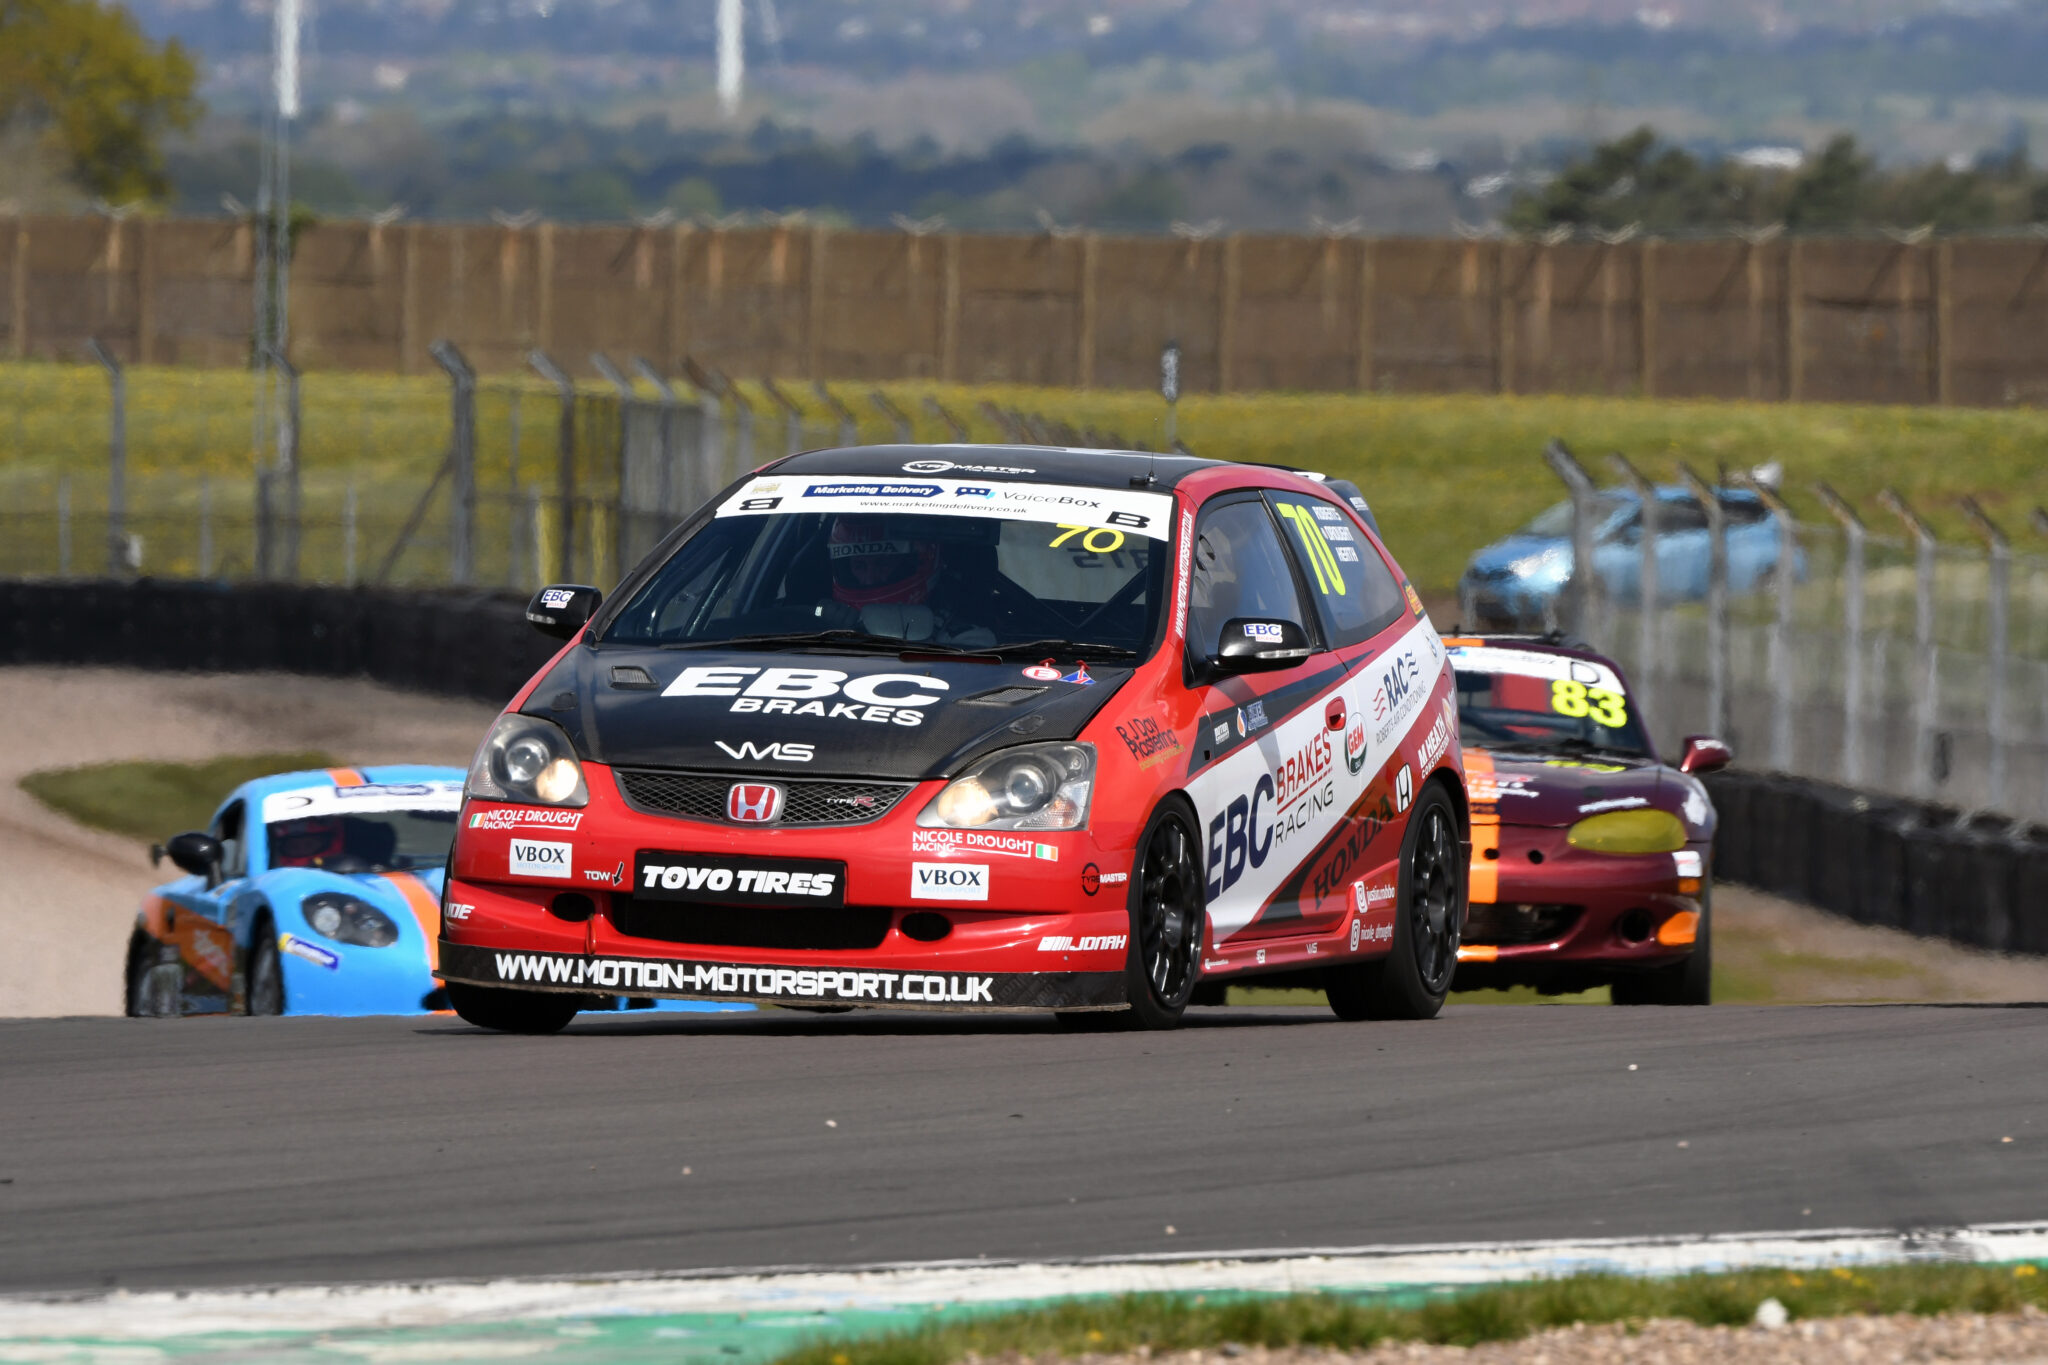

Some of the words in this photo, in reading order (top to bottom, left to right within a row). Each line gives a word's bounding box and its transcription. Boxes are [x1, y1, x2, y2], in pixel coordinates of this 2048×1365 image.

[813, 486, 879, 495] Marketing
[881, 486, 934, 496] Delivery
[1003, 491, 1101, 508] VoiceBox
[860, 501, 1027, 513] www.marketingdelivery.co.uk
[1105, 511, 1150, 528] B
[1049, 523, 1125, 553] 70
[833, 542, 898, 557] HONDA
[1276, 503, 1346, 596] 70
[543, 591, 571, 602] EBC
[1245, 625, 1280, 636] EBC
[660, 667, 950, 707] EBC
[1383, 656, 1409, 712] RAC
[729, 698, 925, 727] BRAKES
[1552, 679, 1628, 728] 83
[1347, 722, 1365, 756] GEM
[1277, 726, 1332, 806] BRAKES
[486, 809, 524, 823] NICOLE
[525, 810, 583, 827] DROUGHT
[1275, 780, 1334, 848] RACING
[483, 821, 514, 830] RACING
[912, 831, 964, 844] NICOLE
[966, 833, 1034, 853] DROUGHT
[912, 842, 956, 852] RACING
[1205, 773, 1275, 905] EBC
[515, 845, 565, 863] VBOX
[1313, 793, 1395, 911] HONDA
[584, 870, 611, 881] TOW
[642, 865, 733, 892] TOYO
[737, 870, 835, 897] TIRES
[918, 869, 981, 886] VBOX
[1070, 935, 1127, 951] JONAH
[495, 953, 993, 1002] WWW.MOTION-MOTORSPORT.CO.UK
